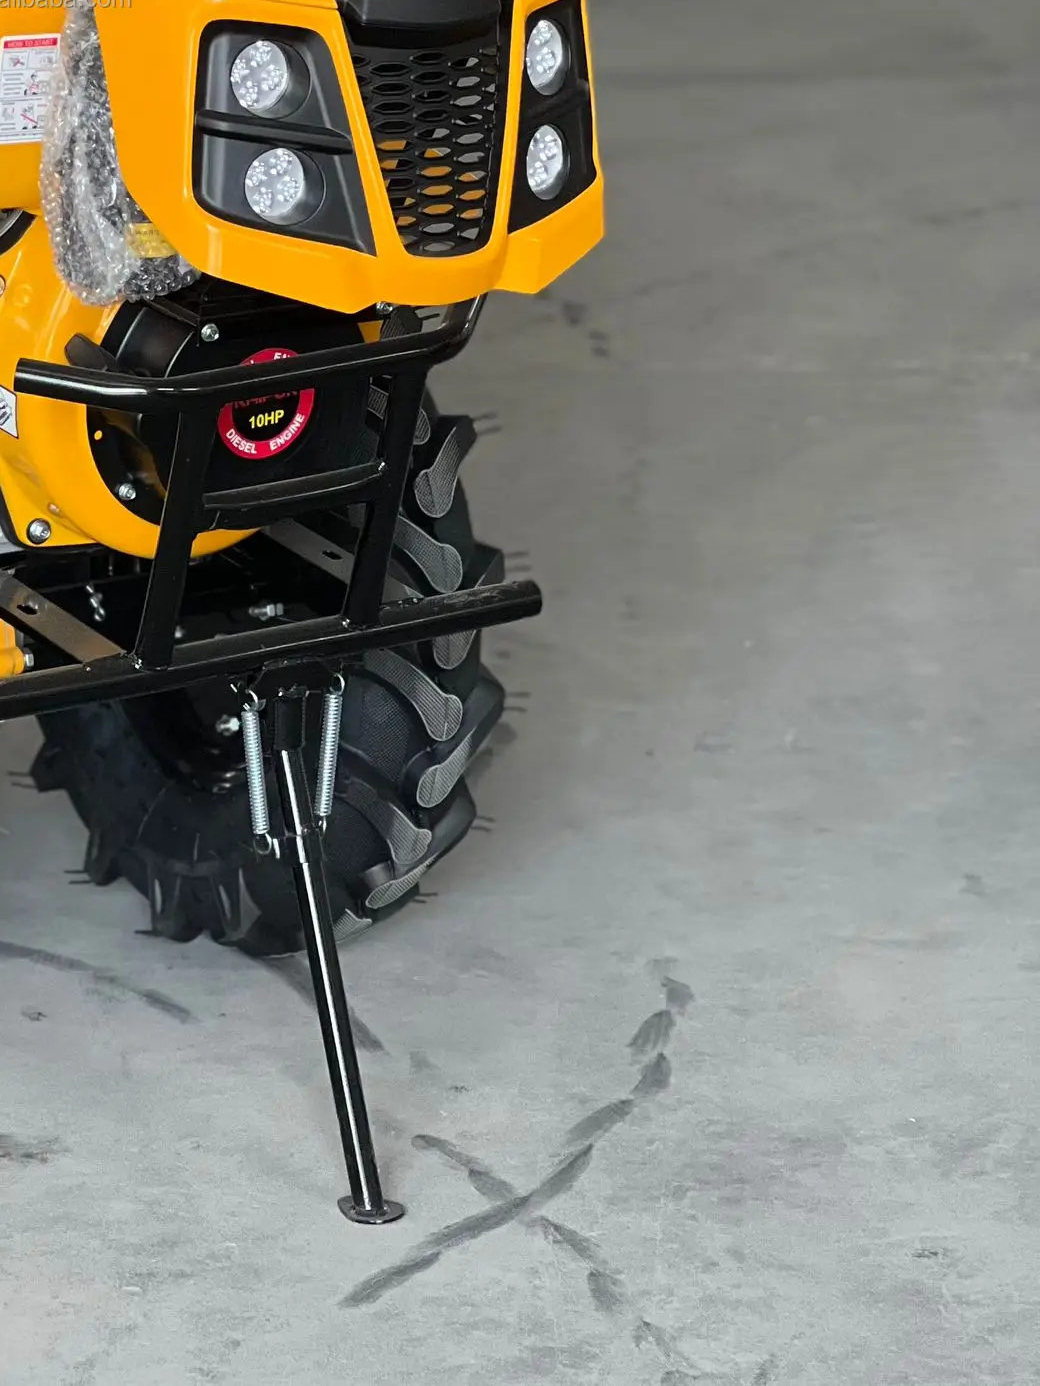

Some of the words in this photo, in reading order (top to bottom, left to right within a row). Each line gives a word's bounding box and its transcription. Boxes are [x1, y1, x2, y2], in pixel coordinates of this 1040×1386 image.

[225, 427, 258, 455] DIESEL
[269, 412, 305, 451] ENGINE
[248, 409, 285, 429] 10HP
